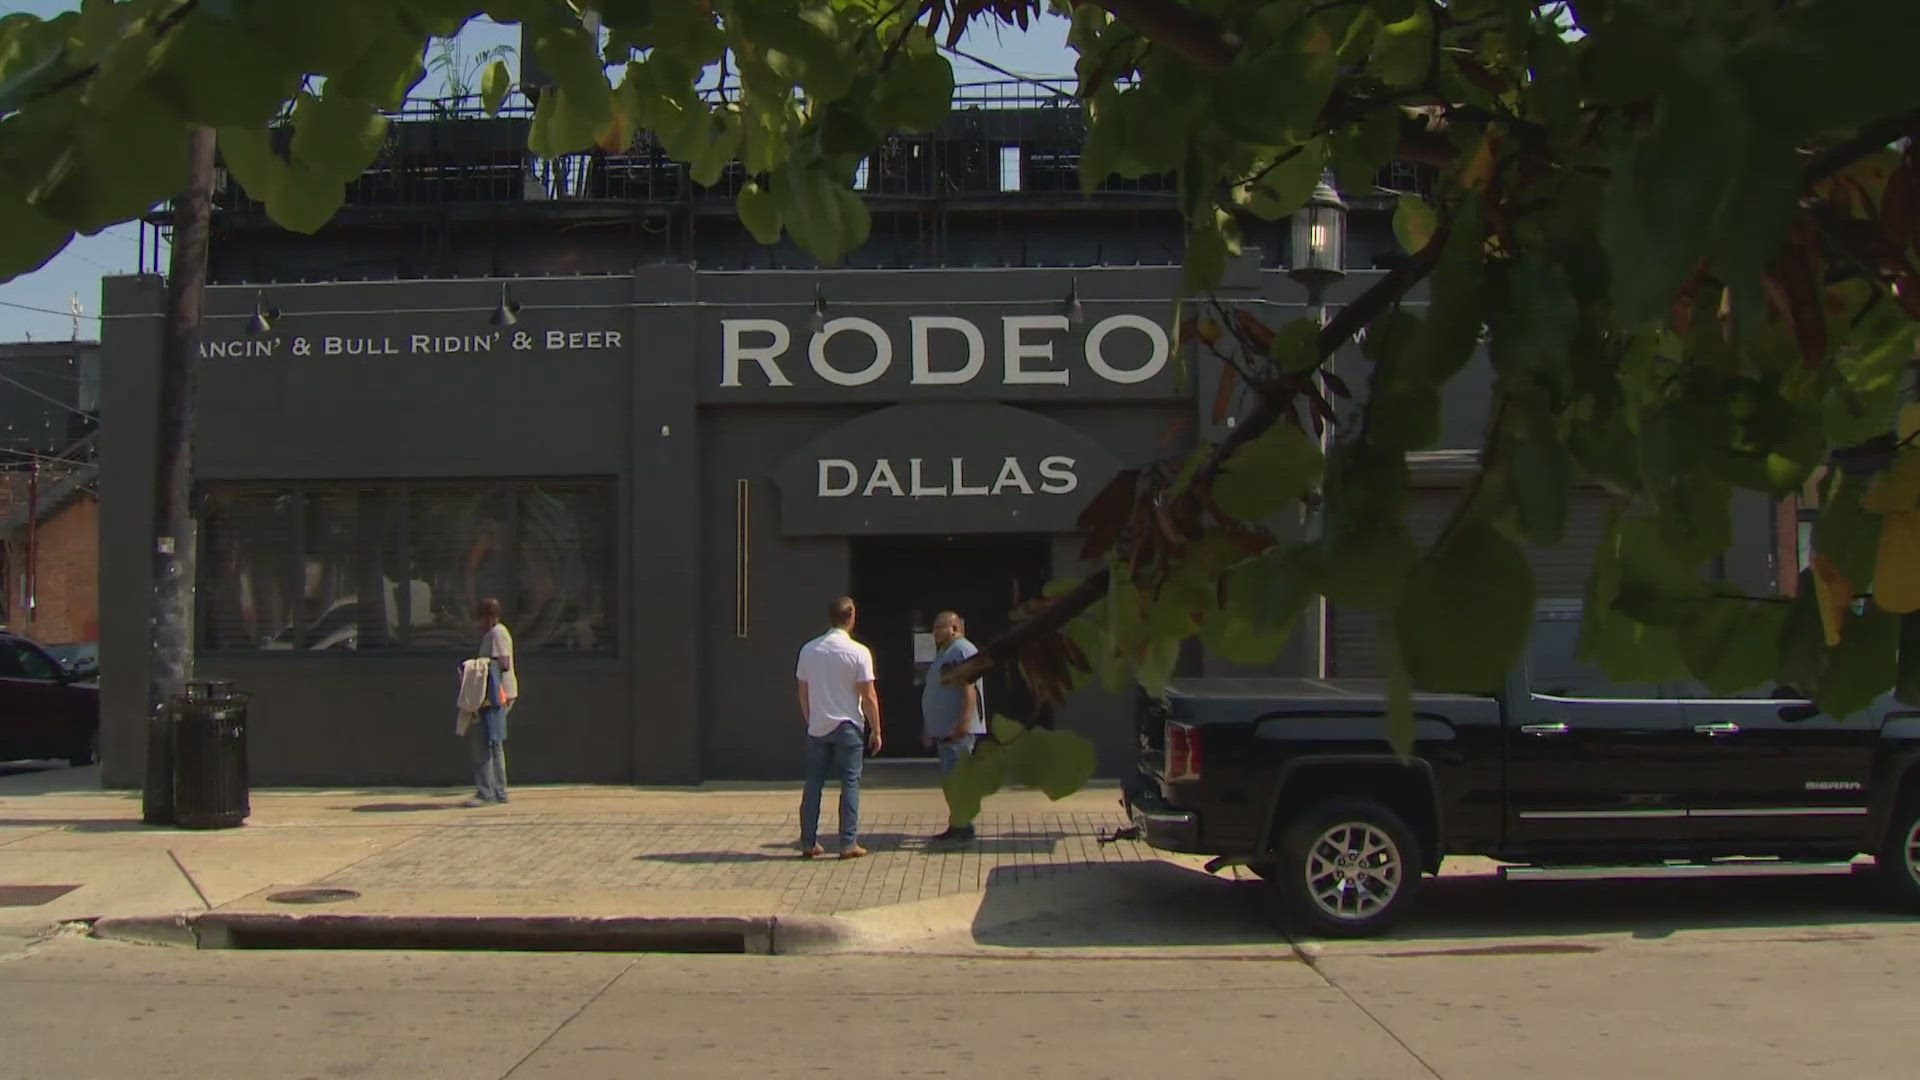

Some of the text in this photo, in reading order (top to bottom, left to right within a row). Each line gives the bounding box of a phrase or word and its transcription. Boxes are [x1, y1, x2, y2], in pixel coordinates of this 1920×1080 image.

[291, 336, 311, 356] &
[324, 336, 399, 355] BULL
[411, 331, 500, 353] RIDIN'
[511, 331, 533, 350] &
[545, 330, 622, 350] BEER
[720, 314, 1169, 387] RODEO
[817, 455, 1078, 498] DALLAS
